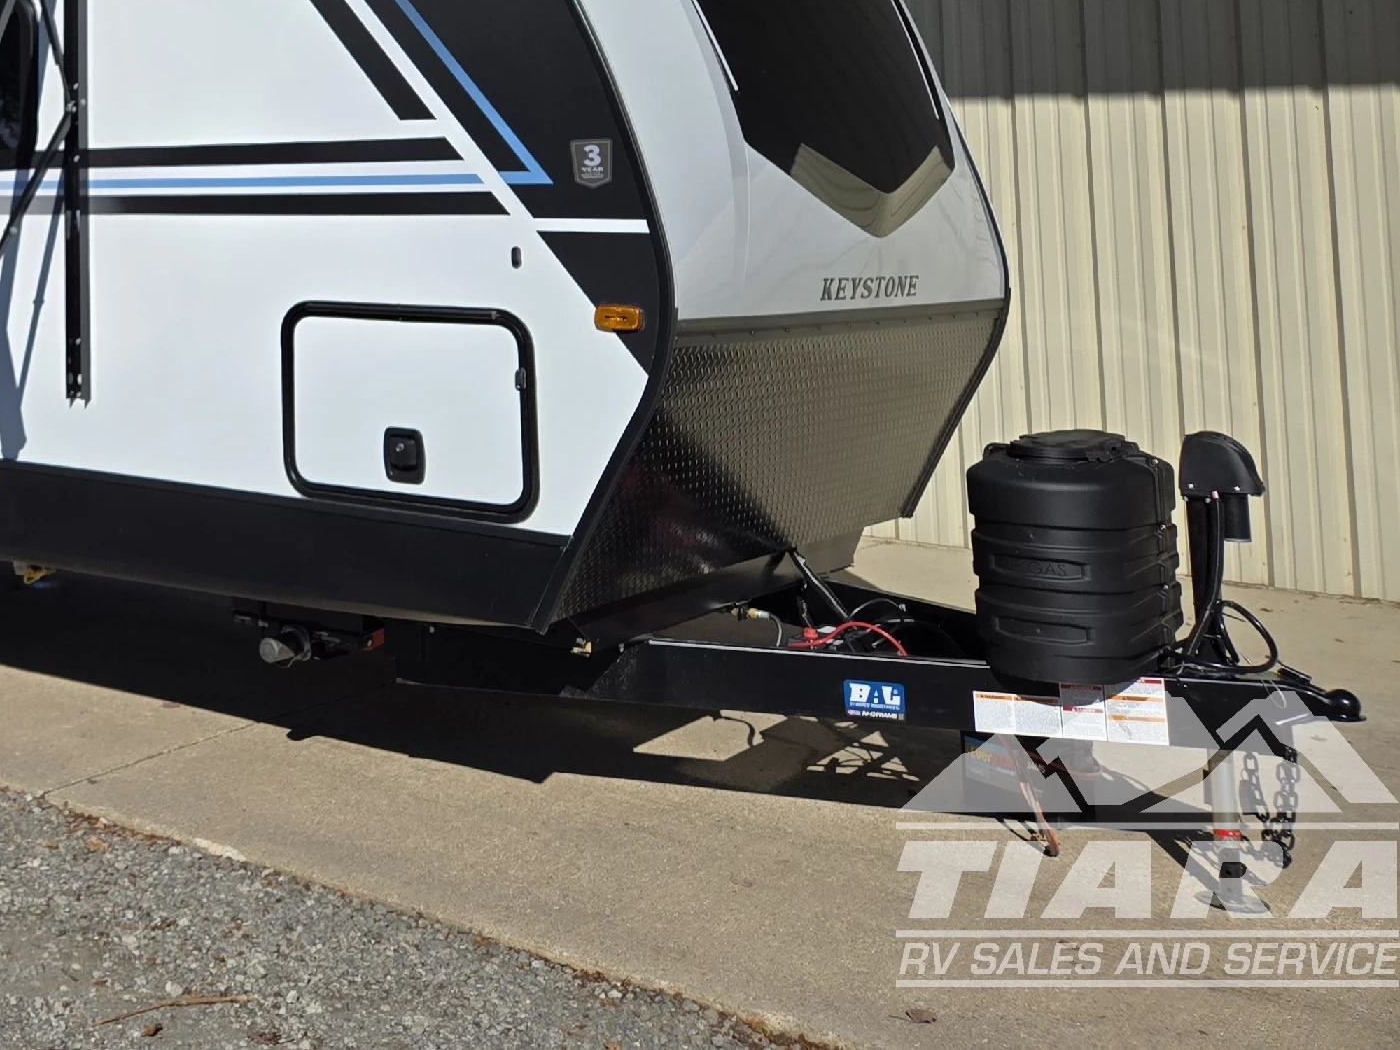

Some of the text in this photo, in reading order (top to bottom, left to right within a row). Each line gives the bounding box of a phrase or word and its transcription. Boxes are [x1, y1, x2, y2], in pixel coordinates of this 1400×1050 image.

[583, 144, 602, 167] 3
[820, 275, 919, 301] KEYSTONE
[1029, 561, 1068, 577] GAS
[849, 682, 901, 706] BAL
